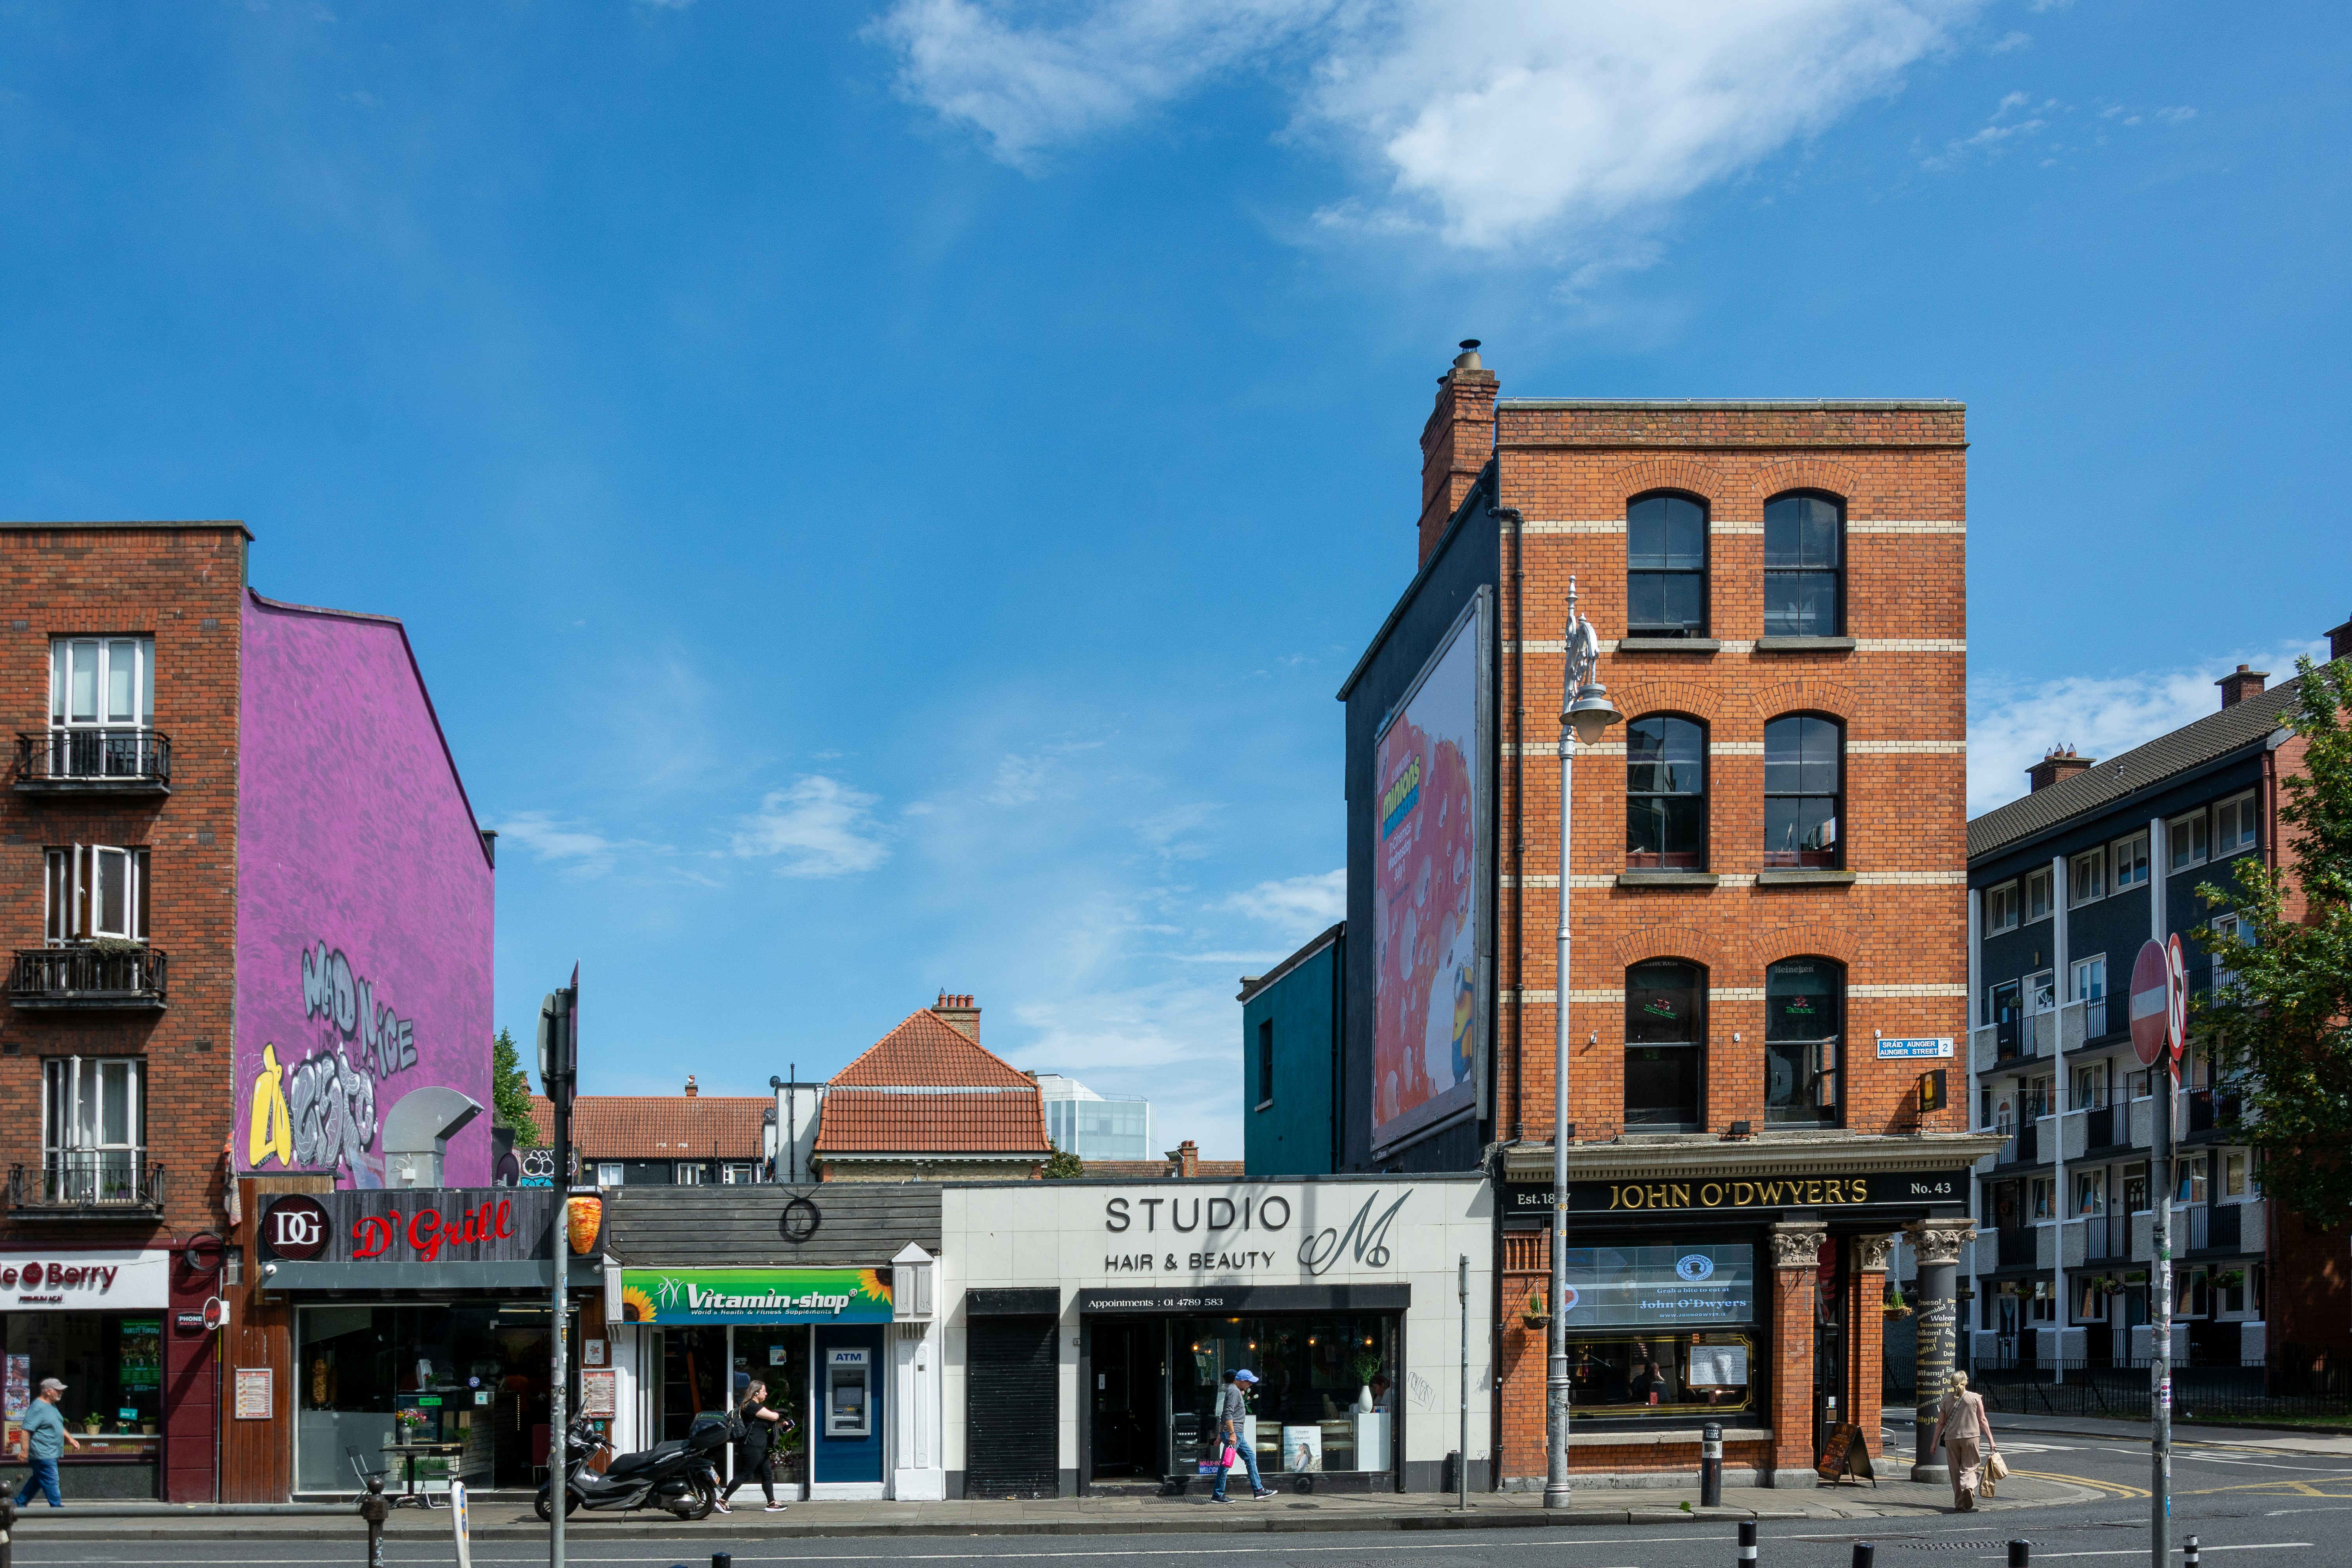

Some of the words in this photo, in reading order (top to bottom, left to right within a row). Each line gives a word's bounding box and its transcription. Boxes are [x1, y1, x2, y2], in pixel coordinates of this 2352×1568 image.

[1388, 837, 1412, 872] Wednesday
[302, 939, 357, 1041] MAD
[1644, 1004, 1677, 1019] Heineken
[1942, 1043, 1948, 1052] 2
[1517, 1194, 1540, 1204] Est.
[1610, 1184, 1691, 1209] JOHN
[1700, 1179, 1867, 1207] O'DWYER'S
[1911, 1183, 1931, 1194] No.
[1934, 1183, 1951, 1193] 43
[1106, 1196, 1290, 1232] STUDIO
[274, 1211, 322, 1245] DG
[352, 1200, 515, 1261] D'Grill
[1105, 1254, 1152, 1272] HAIR
[1164, 1253, 1177, 1270] &
[1189, 1252, 1276, 1271] BEAUTY
[48, 1263, 118, 1288] Berry
[1089, 1299, 1154, 1308] Appointments
[1640, 1300, 1674, 1308] John
